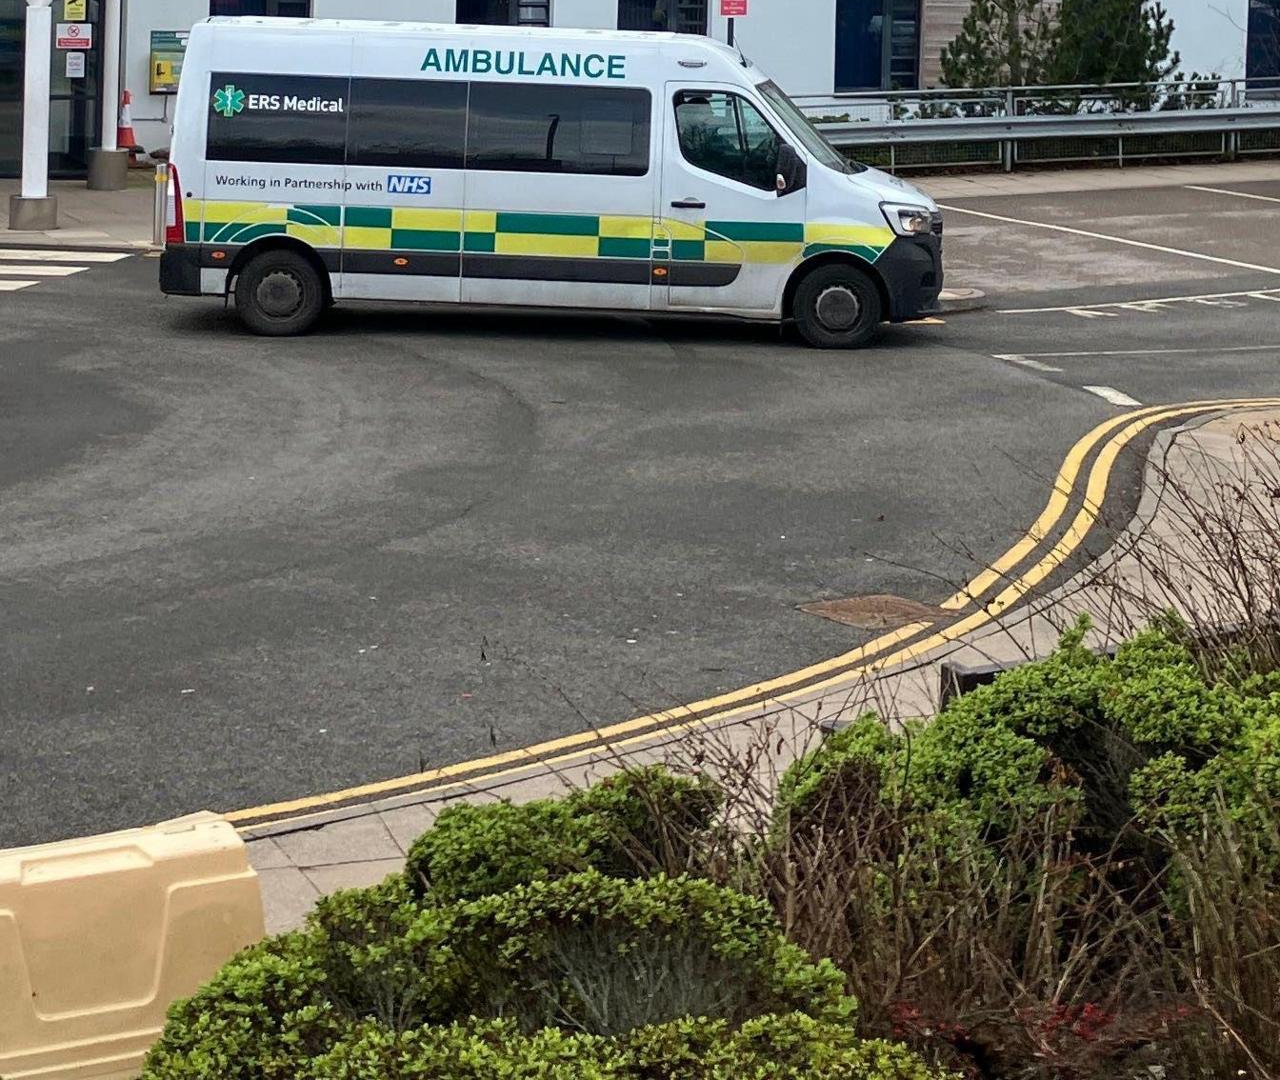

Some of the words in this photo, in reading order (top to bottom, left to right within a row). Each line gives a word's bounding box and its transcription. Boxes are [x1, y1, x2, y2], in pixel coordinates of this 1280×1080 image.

[420, 48, 626, 79] AMBULANCE
[248, 94, 281, 111] ERS
[283, 95, 344, 113] Medical
[215, 175, 266, 189] Working
[270, 177, 281, 188] in
[284, 177, 352, 192] Partnership
[356, 180, 383, 192] with
[388, 176, 431, 193] NHS
